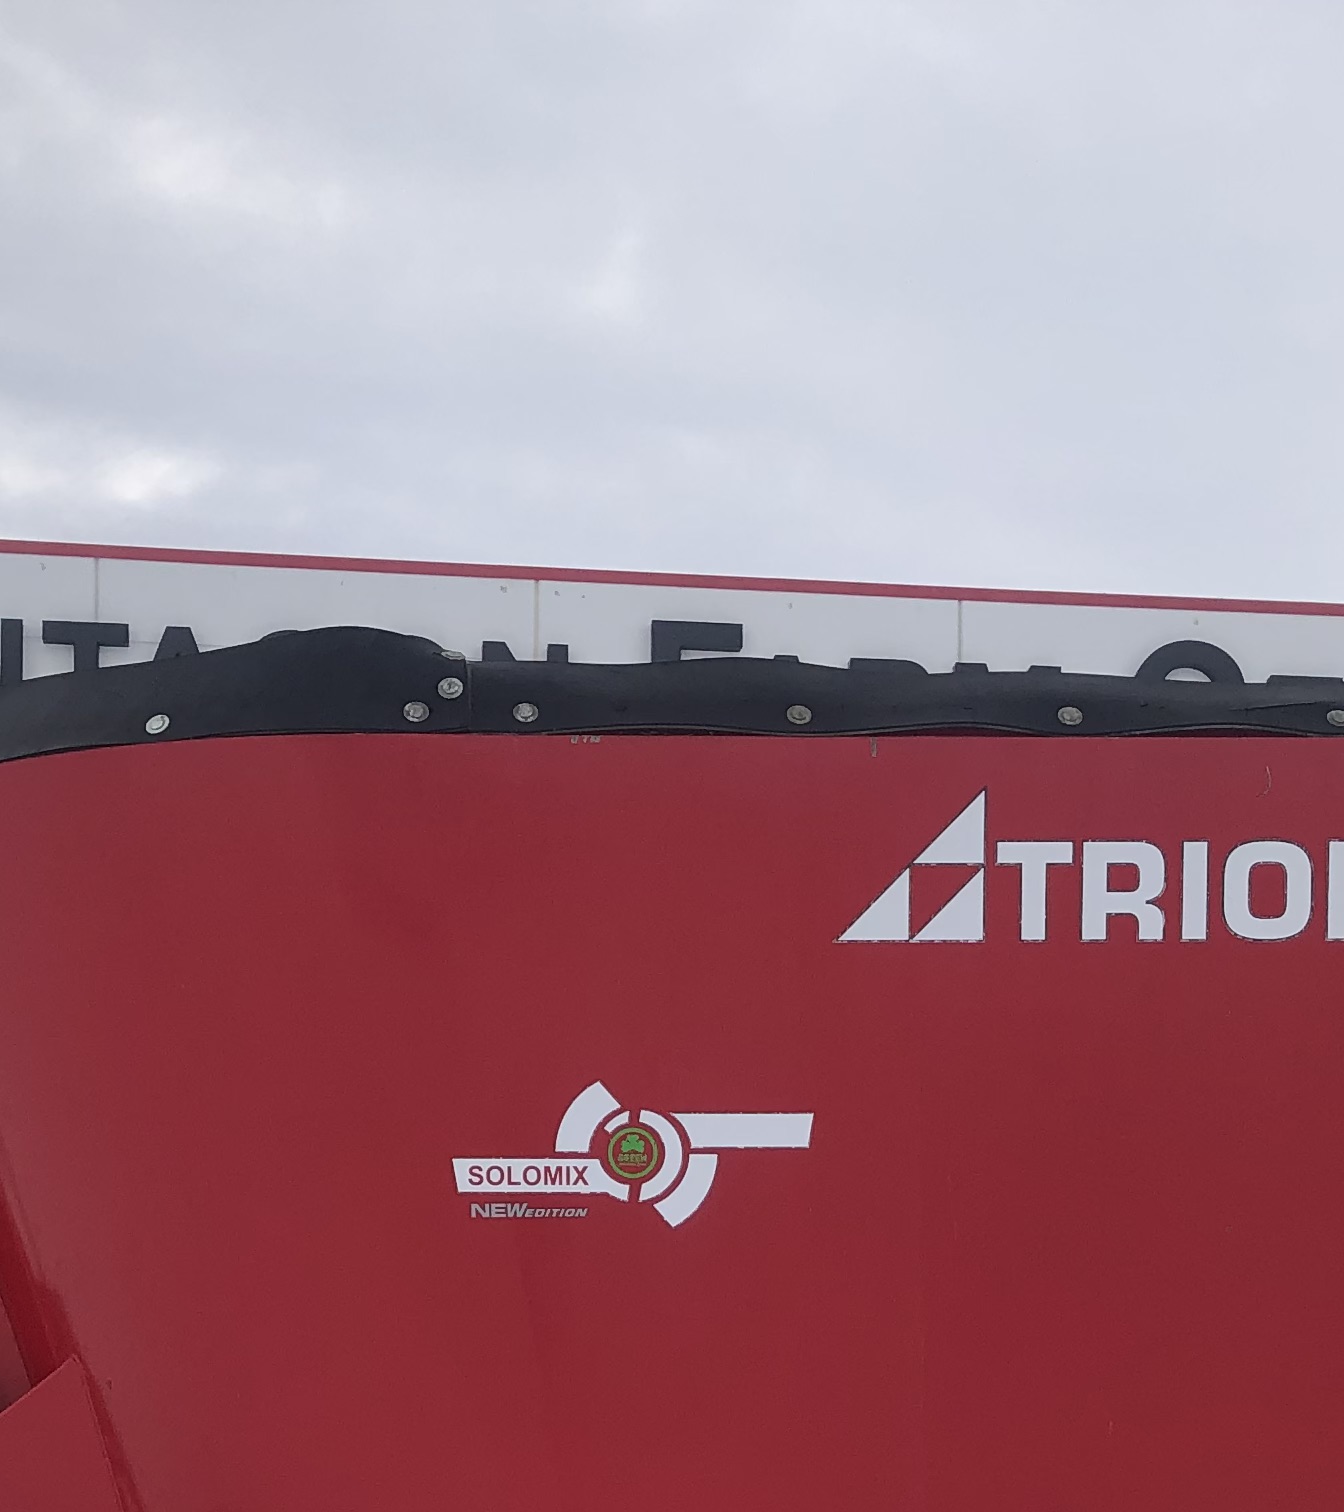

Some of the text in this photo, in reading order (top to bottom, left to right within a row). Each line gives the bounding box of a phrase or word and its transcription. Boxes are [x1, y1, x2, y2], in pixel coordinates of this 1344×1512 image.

[468, 1165, 589, 1186] SOLOMIX
[471, 1203, 588, 1217] NEW EDITION
